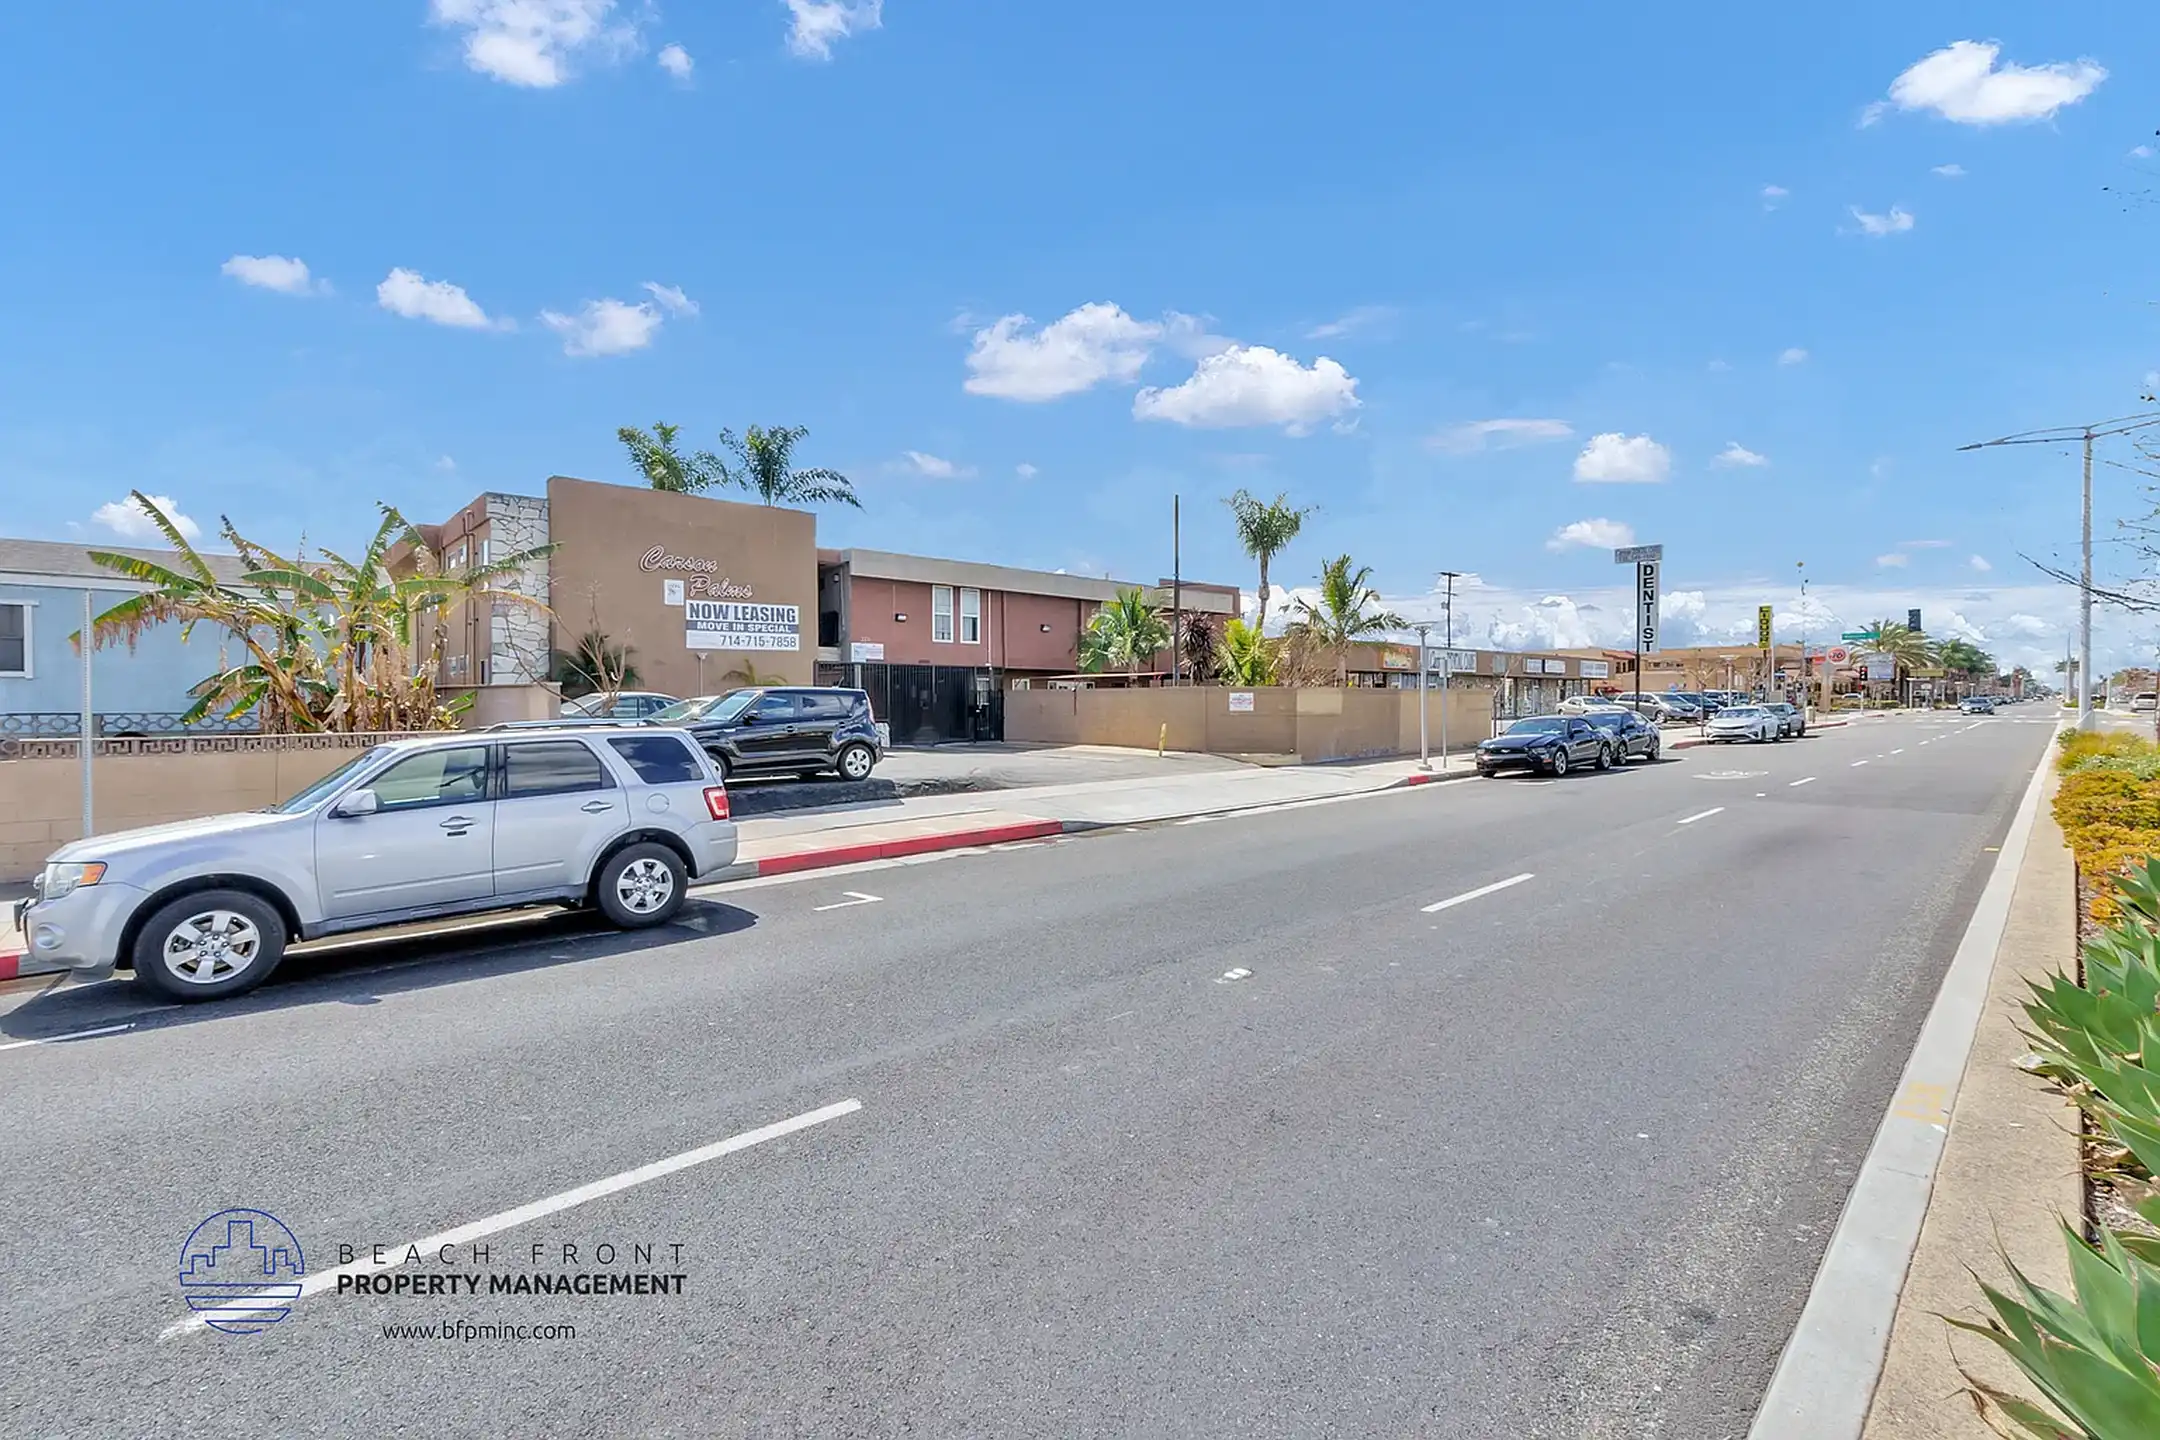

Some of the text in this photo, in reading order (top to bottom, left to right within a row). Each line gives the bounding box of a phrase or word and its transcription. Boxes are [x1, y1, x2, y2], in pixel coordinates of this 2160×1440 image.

[640, 545, 718, 573] Carson
[689, 574, 753, 599] Palms
[689, 603, 796, 623] NOW LEASING
[1642, 564, 1655, 652] DENTIST
[697, 621, 792, 634] MOVE IN SPECIAL
[720, 635, 797, 648] 714-715-7858
